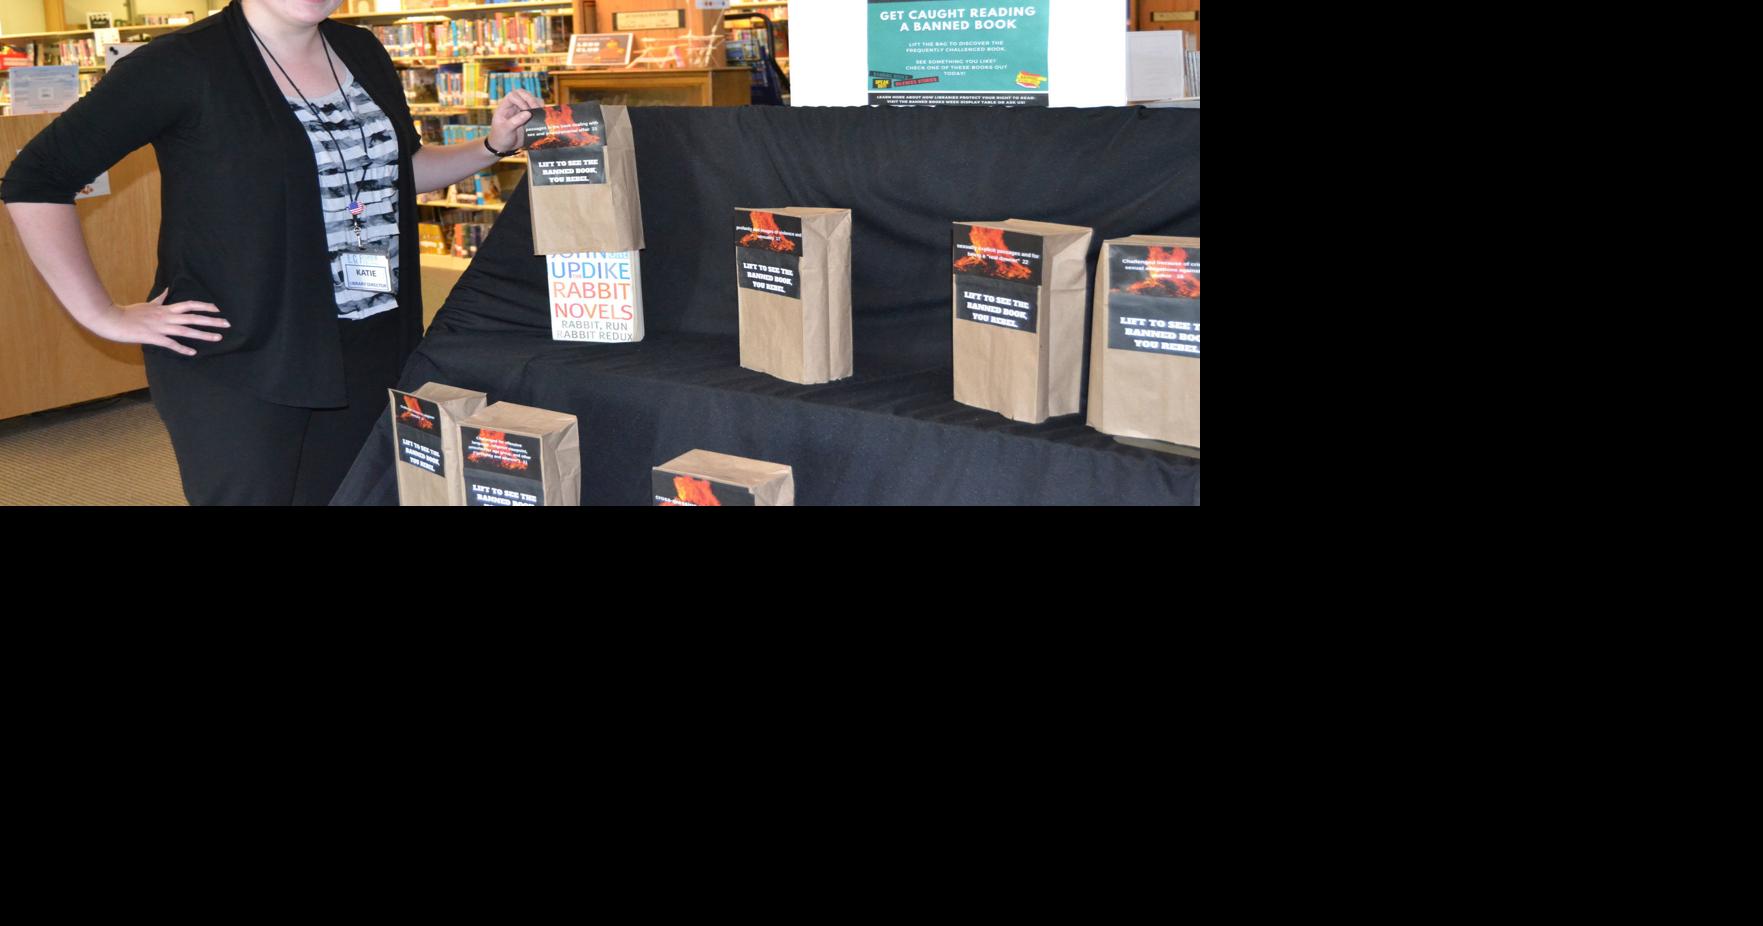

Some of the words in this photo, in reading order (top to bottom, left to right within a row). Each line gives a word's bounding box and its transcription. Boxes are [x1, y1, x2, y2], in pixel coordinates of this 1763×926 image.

[880, 11, 904, 20] GET
[909, 9, 965, 20] CAUGHT
[970, 7, 1036, 18] READING
[900, 22, 910, 32] A
[914, 20, 969, 31] BANNED
[974, 20, 1016, 29] BOOK
[552, 262, 630, 280] UPDIKE
[781, 268, 793, 276] THE
[747, 272, 773, 281] BANNED
[774, 276, 792, 285] BOOK,
[553, 282, 630, 300] RABBIT
[766, 284, 786, 293] REBEL.
[964, 291, 982, 300] LIFT
[996, 297, 1012, 305] SEE
[1013, 300, 1029, 309] THE
[555, 303, 633, 320] NOVELS
[967, 302, 1002, 314] BANNED
[1003, 308, 1028, 320] BOOK,
[562, 320, 602, 330] RABBIT,
[606, 322, 628, 330] RUN
[972, 313, 989, 322] YOU
[991, 317, 1018, 327] REBEL.
[1120, 317, 1146, 325] LIFT
[1149, 319, 1166, 327] TO
[1168, 321, 1190, 330] SEE
[557, 330, 597, 339] RABBIT
[600, 332, 632, 341] REDUX
[1125, 328, 1176, 339] BANNED
[1179, 333, 1200, 342] BOO
[1134, 339, 1158, 348] YOU
[402, 438, 413, 447] LIFT
[430, 449, 440, 457] THE
[405, 448, 425, 459] BANNED
[426, 455, 440, 466] BOOK,
[472, 484, 490, 493] LIFT
[504, 490, 519, 498] SEE
[520, 493, 537, 502] THE
[477, 494, 511, 506] BANNED
